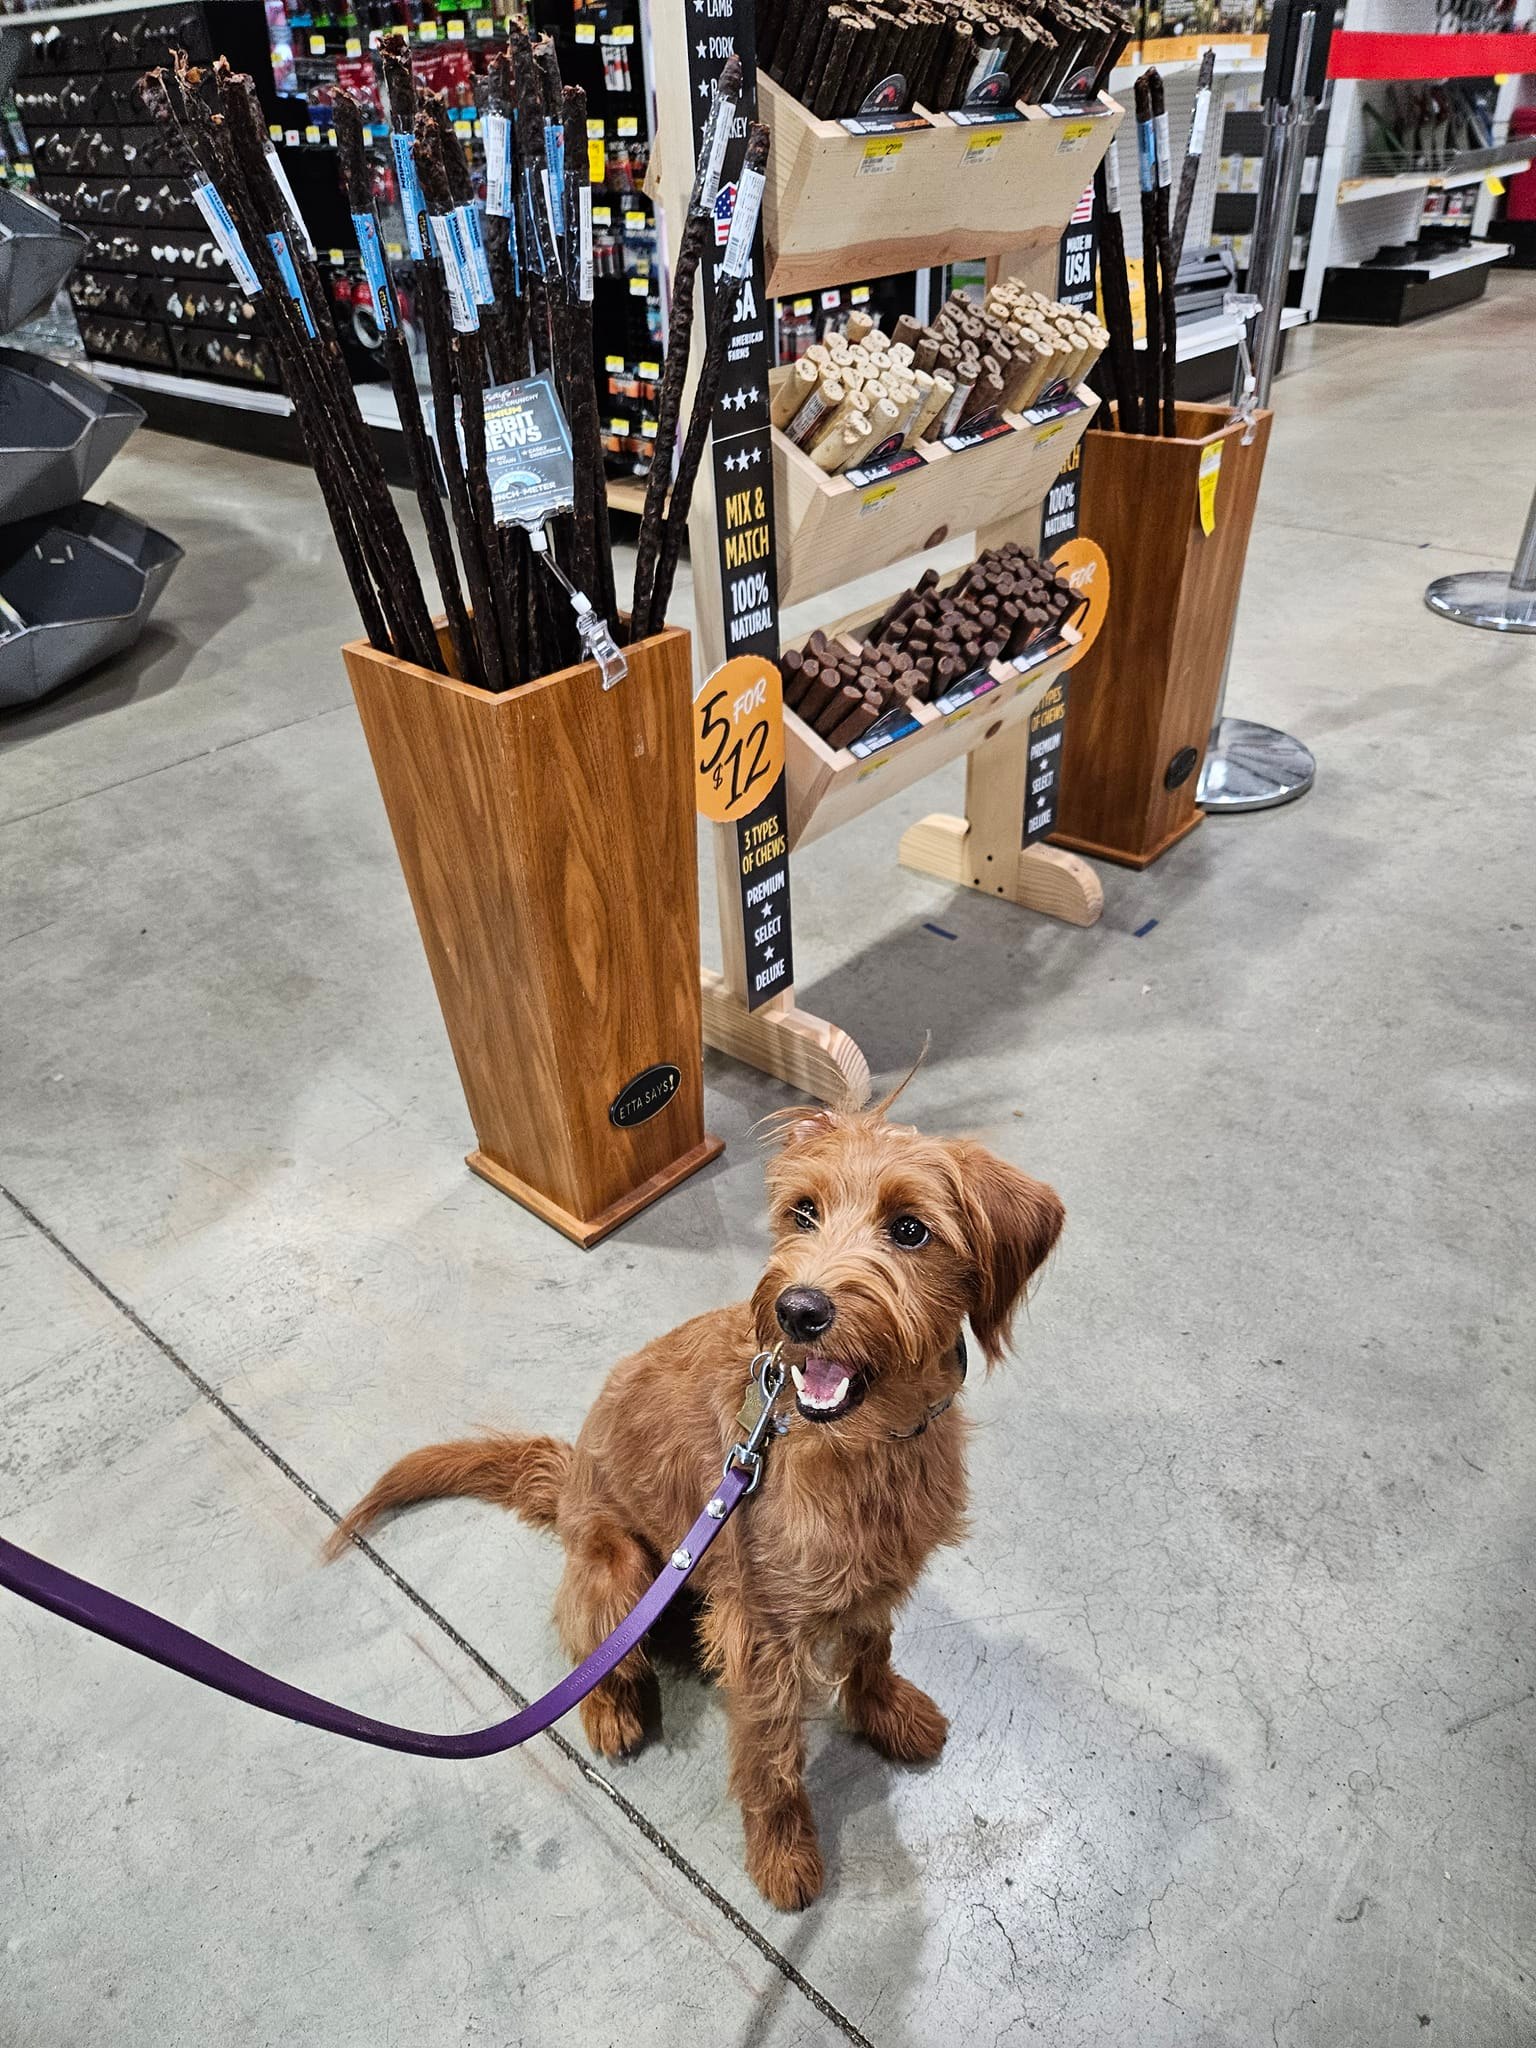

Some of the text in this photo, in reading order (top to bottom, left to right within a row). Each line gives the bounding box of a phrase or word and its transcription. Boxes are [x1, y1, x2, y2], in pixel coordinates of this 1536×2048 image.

[706, 0, 733, 17] LAMB
[708, 36, 735, 59] PORK
[1065, 251, 1090, 287] USA
[728, 346, 750, 361] FARMS
[732, 330, 764, 349] AMERICAN
[725, 486, 766, 529] MIX &
[1048, 482, 1076, 516] 100%
[1043, 511, 1076, 539] NATURAL
[725, 524, 770, 570] MATCH
[731, 571, 769, 615] 100%
[730, 606, 773, 643] NATURAL
[700, 677, 768, 775] 5 FOR
[1030, 731, 1063, 761] PREMIUM
[712, 719, 772, 811] $12
[1031, 770, 1055, 796] SELECT
[744, 815, 780, 851] 3 TYPES
[1028, 808, 1052, 834] DELUXE
[742, 835, 786, 876] OF CHEWS
[747, 870, 785, 909] PREMIUM
[754, 915, 783, 947] SELECT
[755, 958, 786, 992] DELUXE
[619, 1073, 675, 1121] ETTA SAYS!
